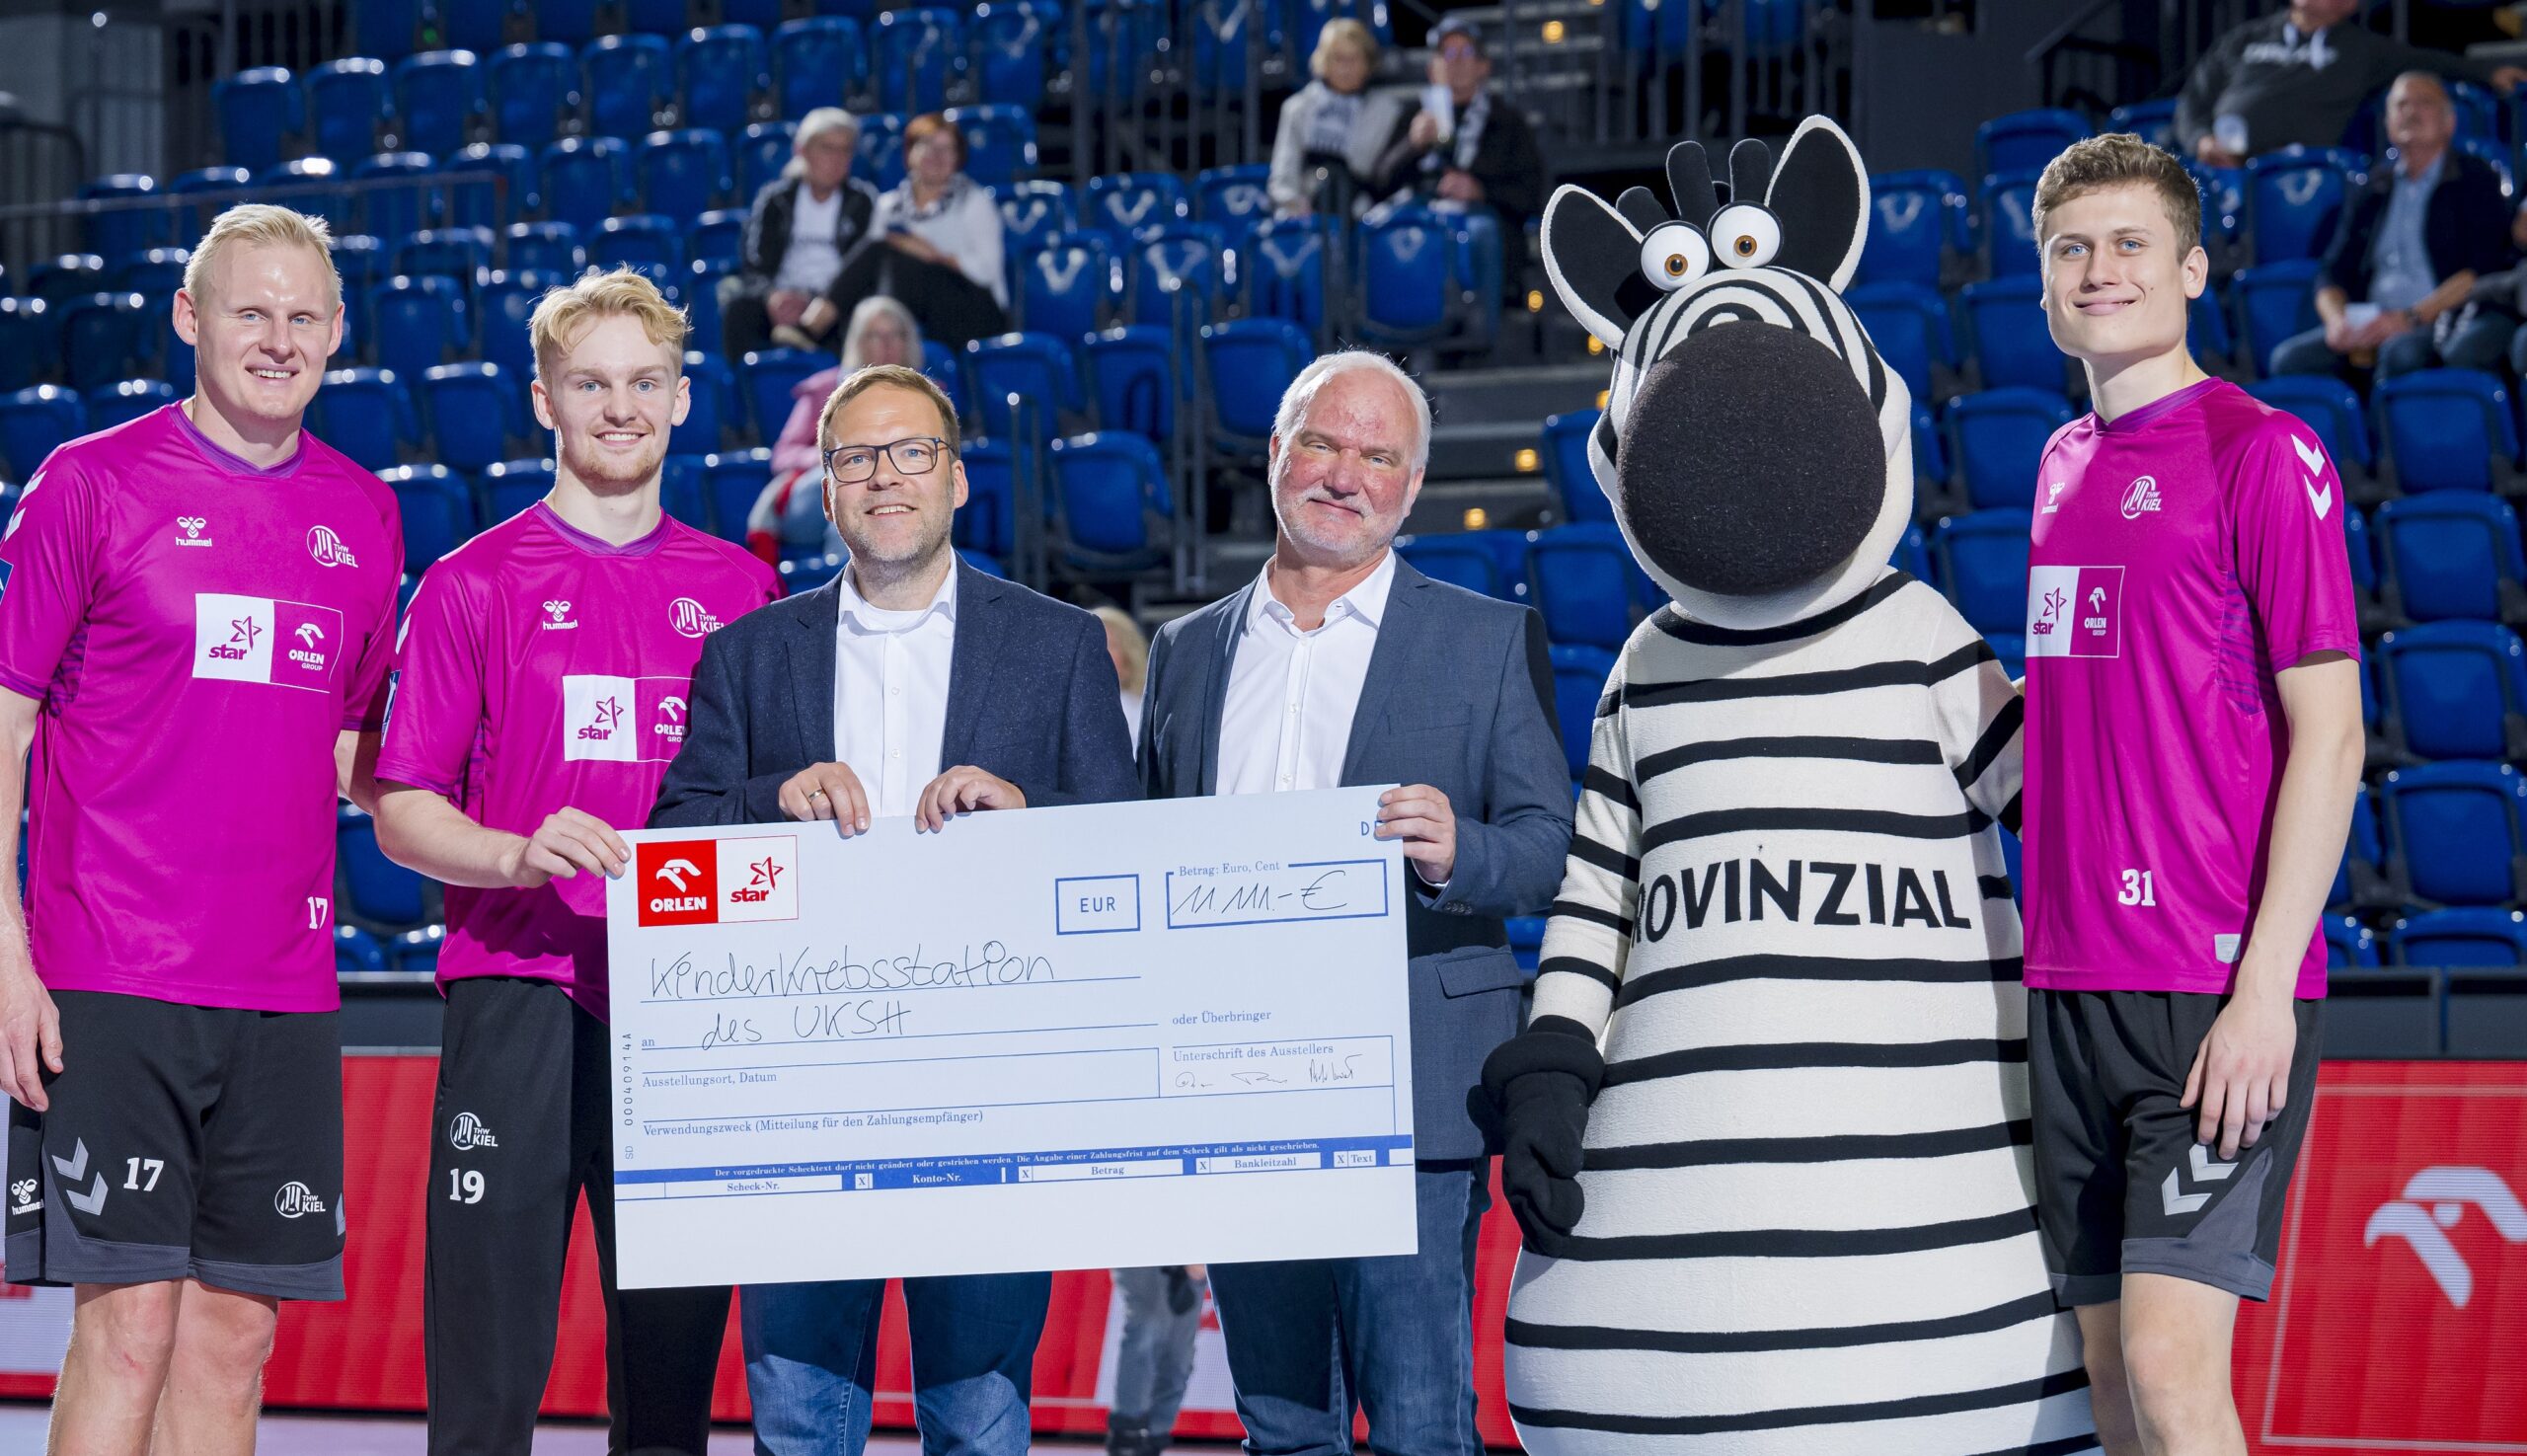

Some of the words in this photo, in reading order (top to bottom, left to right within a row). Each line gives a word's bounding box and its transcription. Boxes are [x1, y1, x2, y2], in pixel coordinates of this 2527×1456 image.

[2141, 498, 2162, 511] KIEL
[175, 536, 212, 548] hummel
[334, 543, 348, 553] THW
[336, 551, 358, 569] KIEL
[543, 619, 578, 631] hummel
[2032, 619, 2053, 635] star
[2084, 617, 2106, 629] ORLEN
[208, 644, 248, 660] star
[288, 649, 325, 664] ORLEN
[301, 662, 323, 671] GROUP
[577, 725, 611, 741] star
[1179, 866, 1219, 878] Betrag:
[1222, 863, 1252, 875] Euro,
[1255, 860, 1280, 872] Cent
[730, 887, 770, 904] star
[2117, 869, 2157, 907] 31
[650, 895, 707, 913] ORLEN
[1080, 896, 1116, 913] EUR
[1631, 858, 1971, 949] ROVINZIAL
[307, 895, 329, 930] 17
[702, 1013, 762, 1051] des
[795, 999, 912, 1038] UKSH
[1172, 1014, 1198, 1025] oder
[1201, 1010, 1271, 1025] Überbringer
[642, 1037, 655, 1047] an
[1174, 1047, 1244, 1062] Unterschrift
[1247, 1046, 1266, 1058] des
[1269, 1043, 1334, 1057] Ausstellers
[643, 1074, 735, 1087] Ausstellungsort,
[739, 1072, 777, 1083] Datum
[644, 1120, 751, 1136] Verwendungszweck
[755, 1118, 818, 1133] (Mitteilung
[822, 1116, 839, 1127] für
[842, 1115, 863, 1127] den
[867, 1110, 983, 1126] Zahlungsempfänger)
[473, 1134, 498, 1147] KIEL
[732, 1167, 786, 1177] vorgedruckte
[835, 1163, 852, 1172] darf
[855, 1162, 876, 1171] nicht
[878, 1160, 913, 1170] geändert
[916, 1159, 935, 1168] oder
[938, 1158, 979, 1168] gestrichen
[1034, 1153, 1064, 1163] Angabe
[1066, 1152, 1087, 1161] einer
[1090, 1150, 1143, 1159] Zahlungsfrist
[1146, 1148, 1161, 1157] auf
[1214, 1145, 1228, 1154] gilt
[1247, 1143, 1266, 1152] nicht
[1269, 1142, 1320, 1152] geschrieben.
[1199, 1161, 1207, 1170] X
[1234, 1157, 1297, 1169] Bankleitzahl
[1337, 1155, 1345, 1164] X
[1350, 1154, 1373, 1164] Text
[123, 1157, 165, 1192] 17
[912, 1173, 962, 1184] Konto-Nr.
[1022, 1169, 1030, 1179] X
[1091, 1166, 1125, 1176] Betrag
[449, 1168, 485, 1204] 19
[727, 1181, 781, 1192] Scheck-Nr.
[858, 1177, 867, 1186] X
[11, 1198, 44, 1216] hummel
[302, 1201, 326, 1212] KIEL
